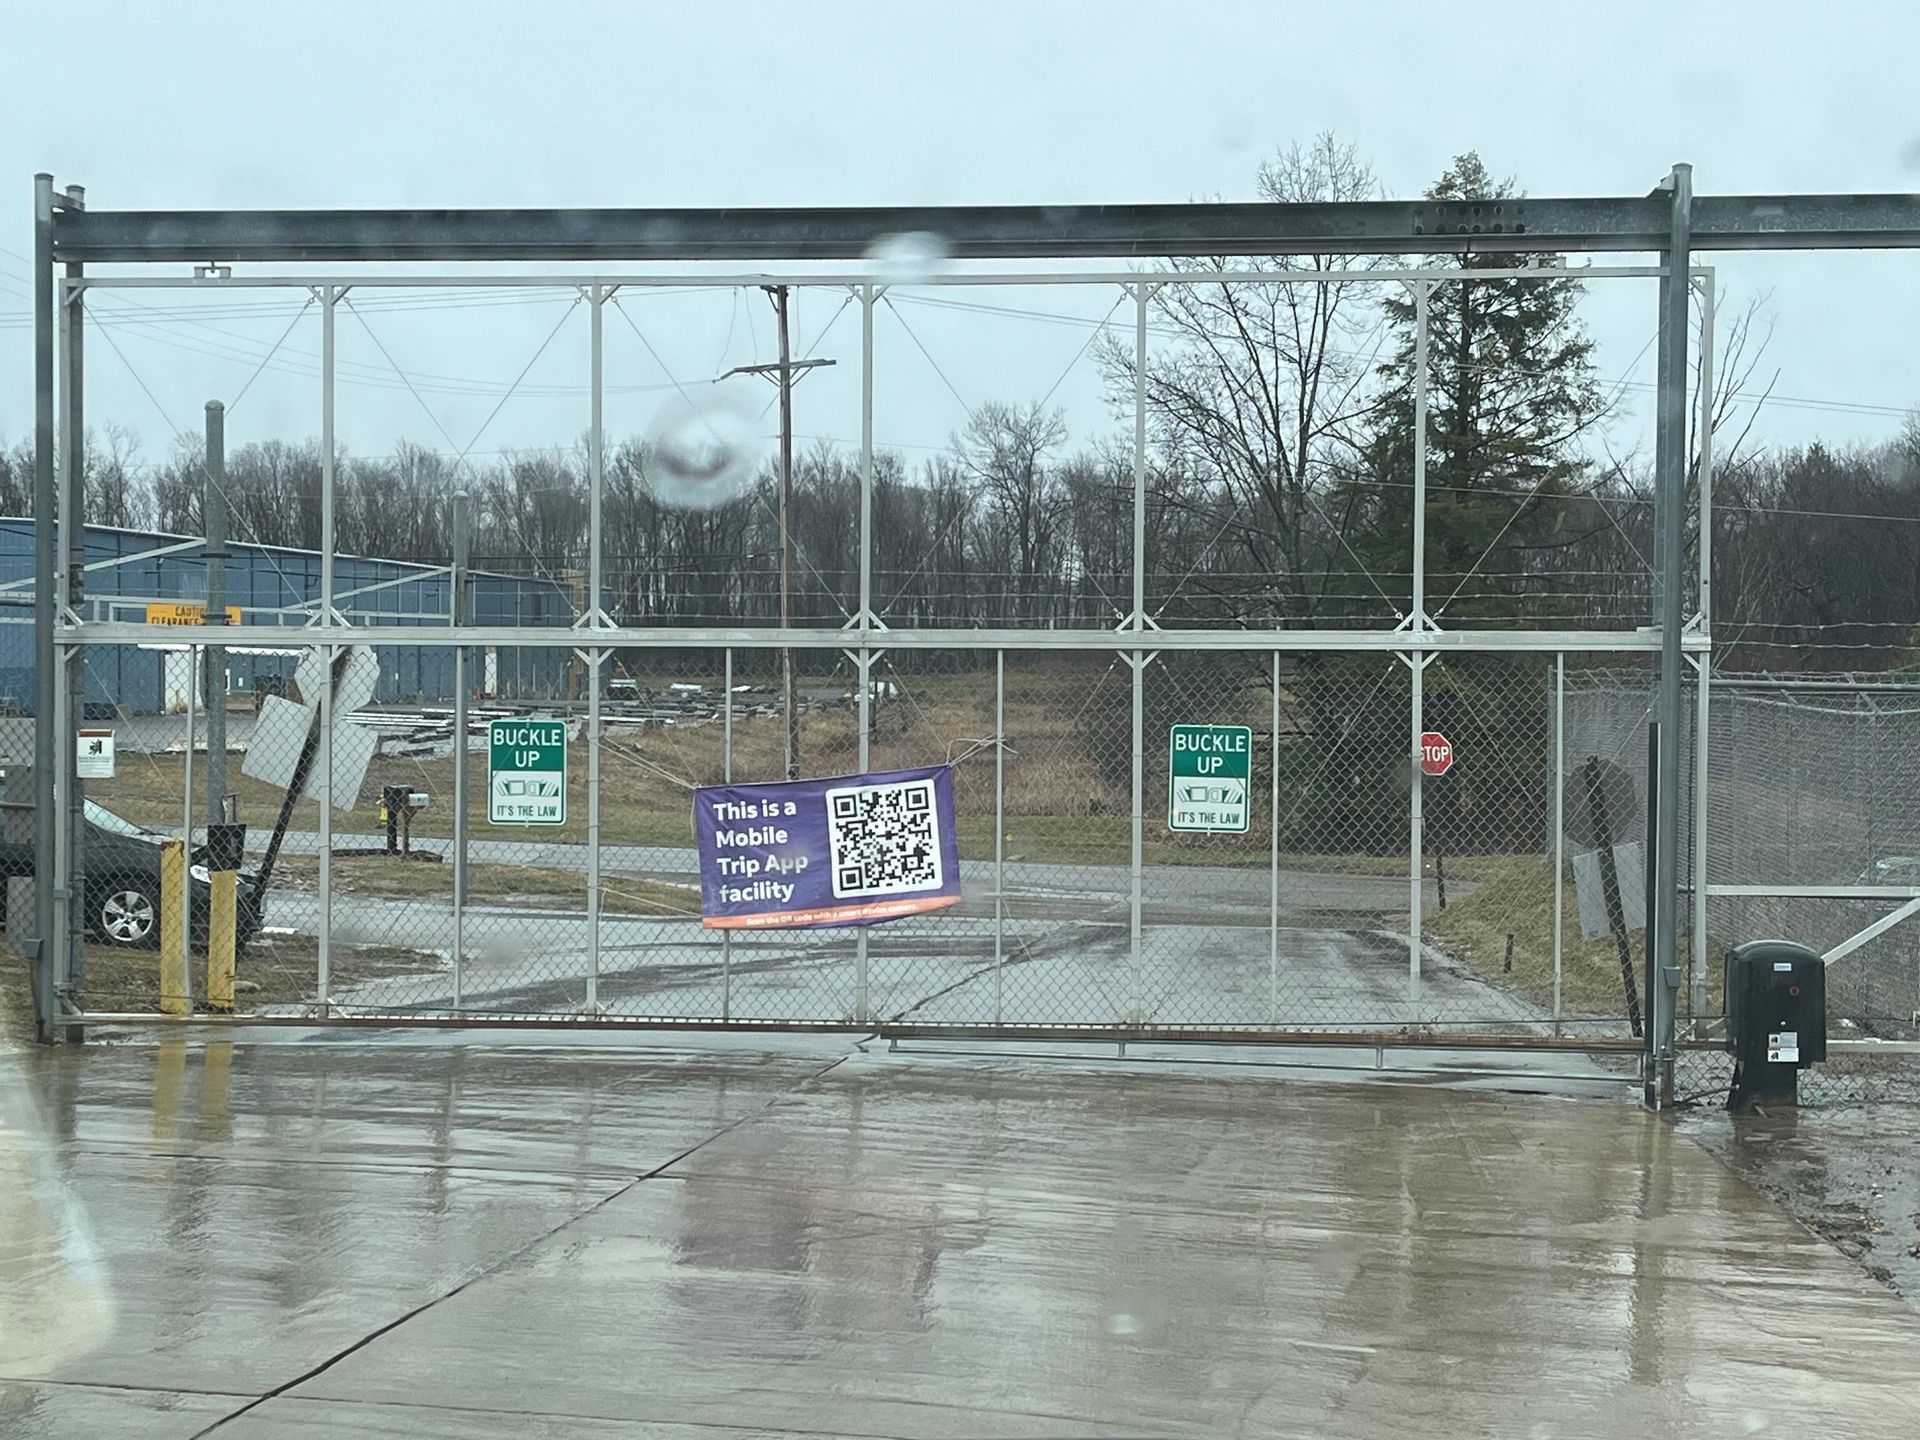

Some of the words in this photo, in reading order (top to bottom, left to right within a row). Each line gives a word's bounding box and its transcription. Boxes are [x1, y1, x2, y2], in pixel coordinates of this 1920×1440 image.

[175, 606, 207, 617] CAUTIO
[493, 729, 562, 746] BUCKLE
[1175, 733, 1246, 752] BUCKLE
[515, 750, 540, 767] UP
[1197, 756, 1223, 774] UP
[497, 805, 514, 816] IT'S
[517, 805, 533, 817] THE
[537, 805, 557, 817] LAW
[713, 800, 757, 821] This
[762, 799, 779, 817] is
[784, 801, 797, 816] a
[1178, 812, 1195, 823] IT'S
[1198, 812, 1216, 824] THE
[1220, 813, 1240, 824] LAW
[716, 826, 788, 848] Mobile
[716, 856, 760, 878] Trip
[765, 854, 808, 875] App
[719, 881, 795, 903] facility
